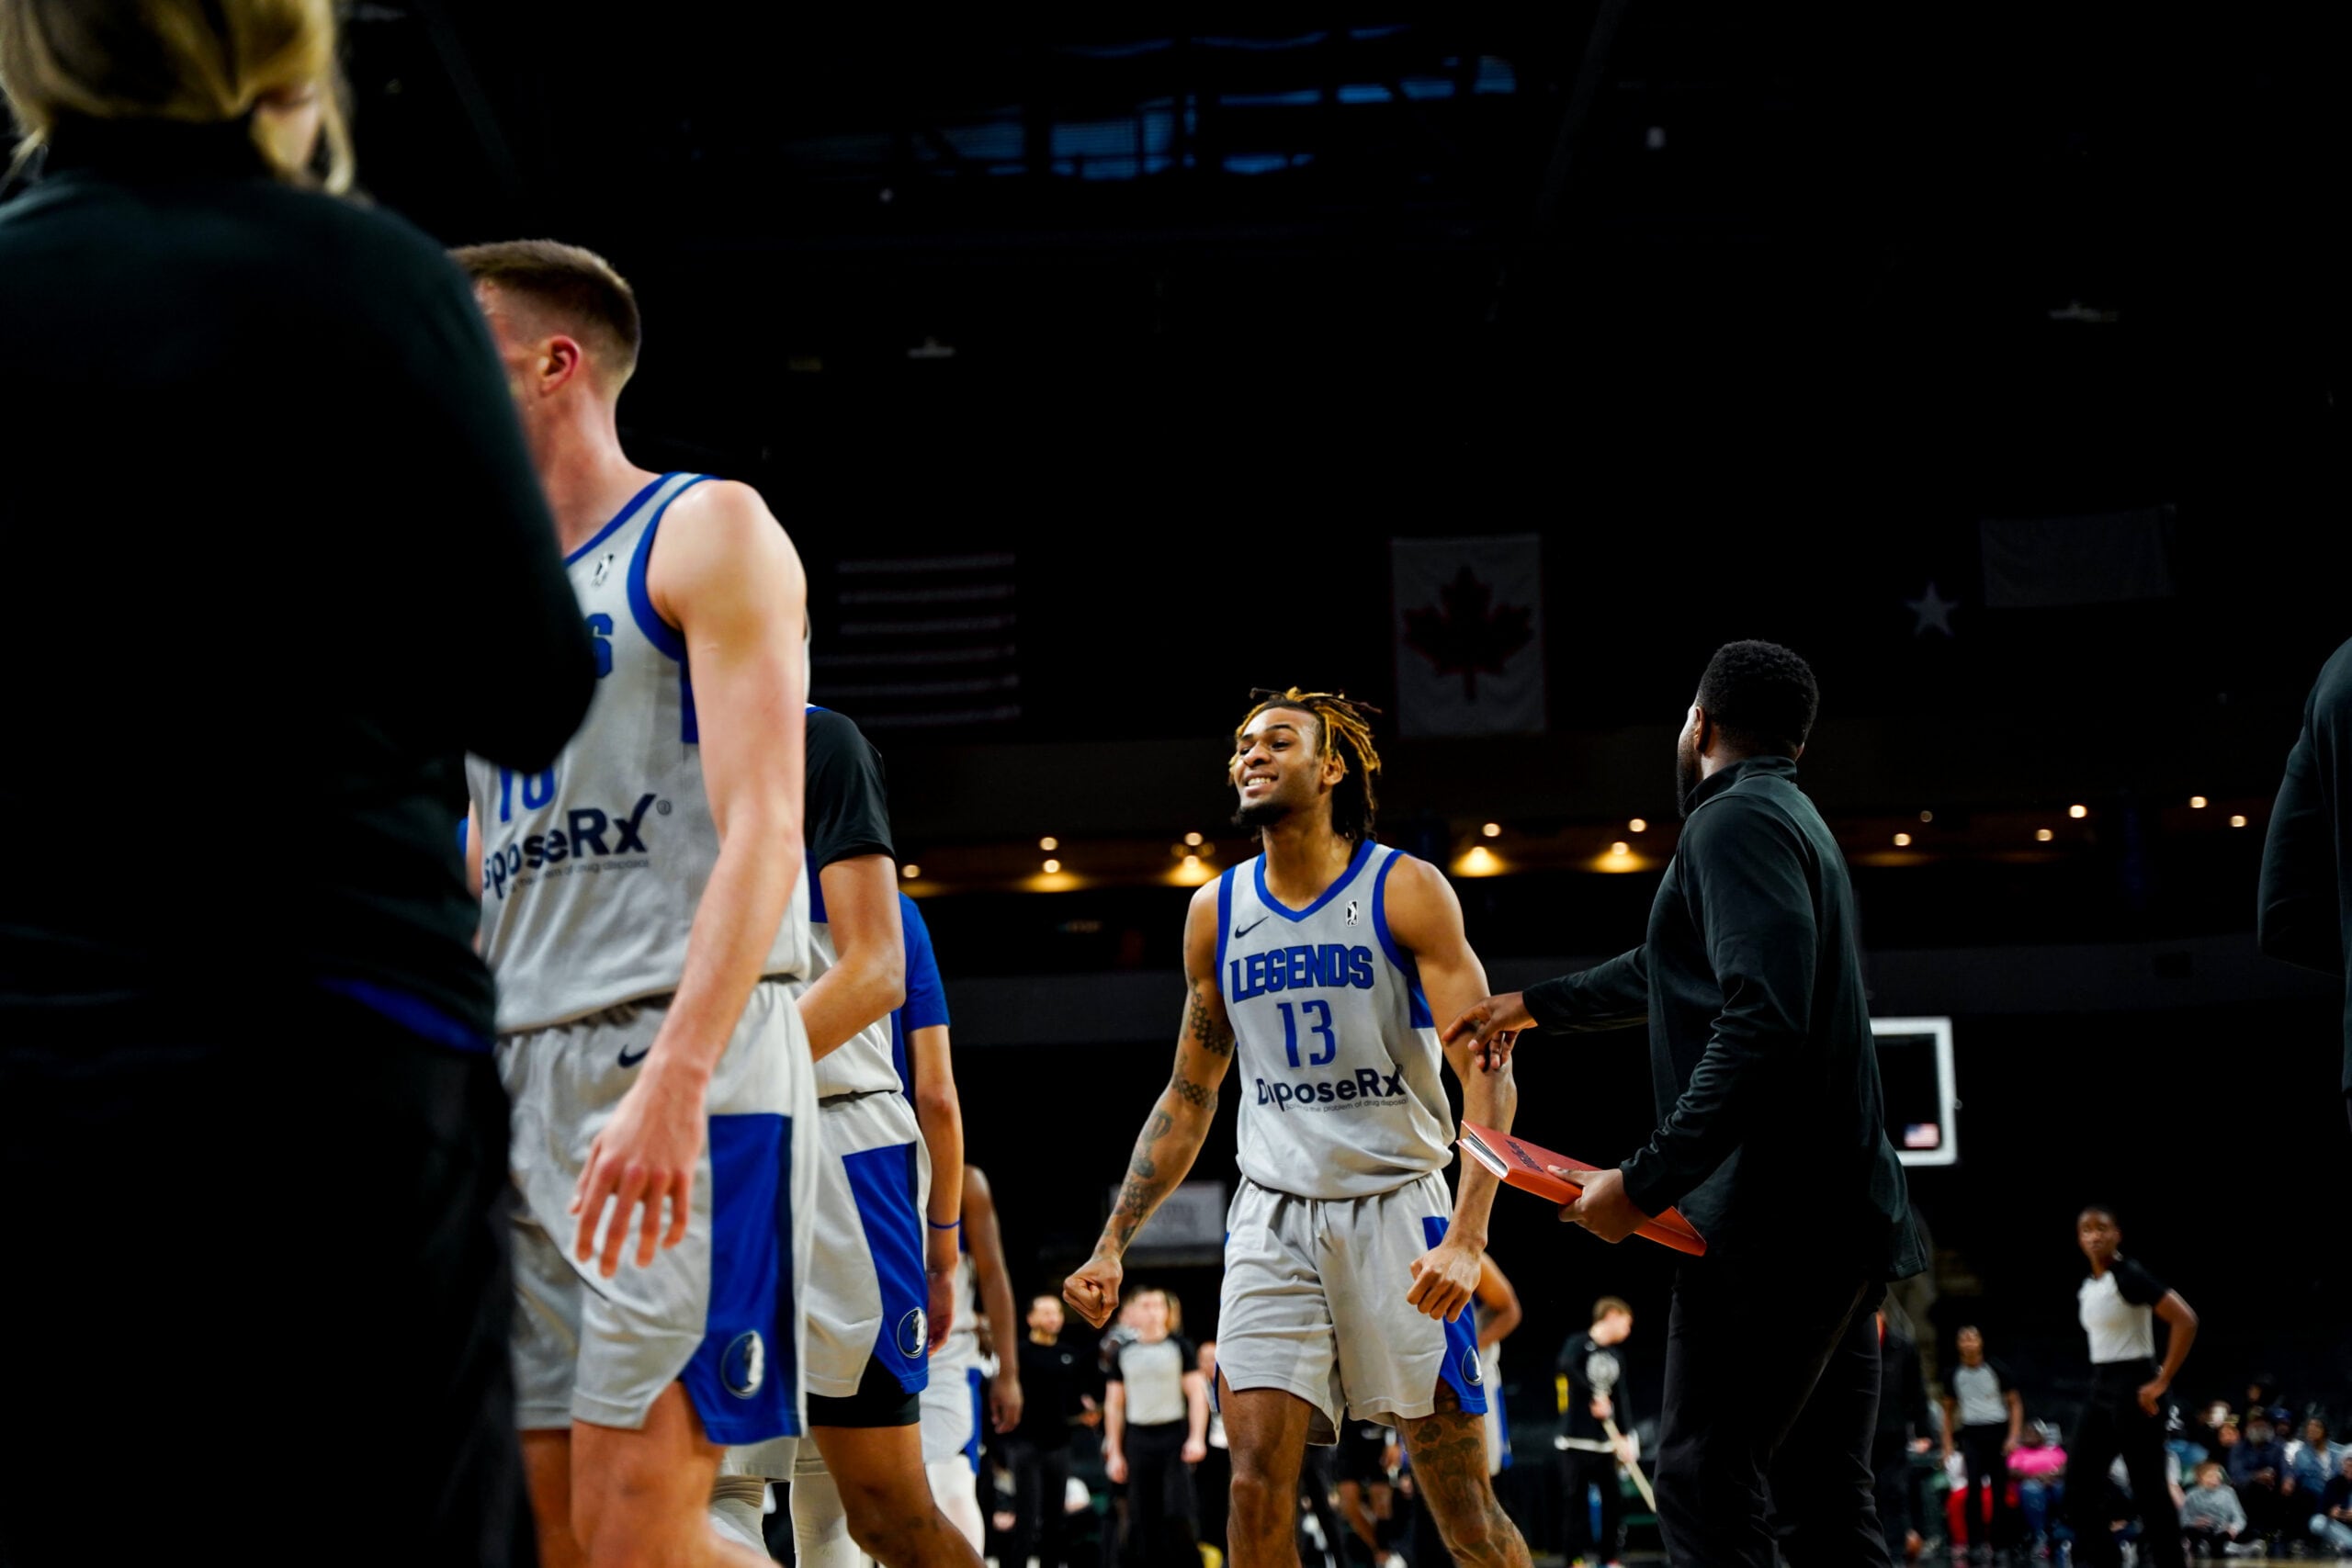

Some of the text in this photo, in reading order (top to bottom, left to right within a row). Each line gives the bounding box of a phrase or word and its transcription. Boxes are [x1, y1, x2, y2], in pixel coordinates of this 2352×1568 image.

[1229, 943, 1374, 1003] LEGENDS
[1277, 999, 1337, 1068] 13
[1323, 1102, 1353, 1113] problem
